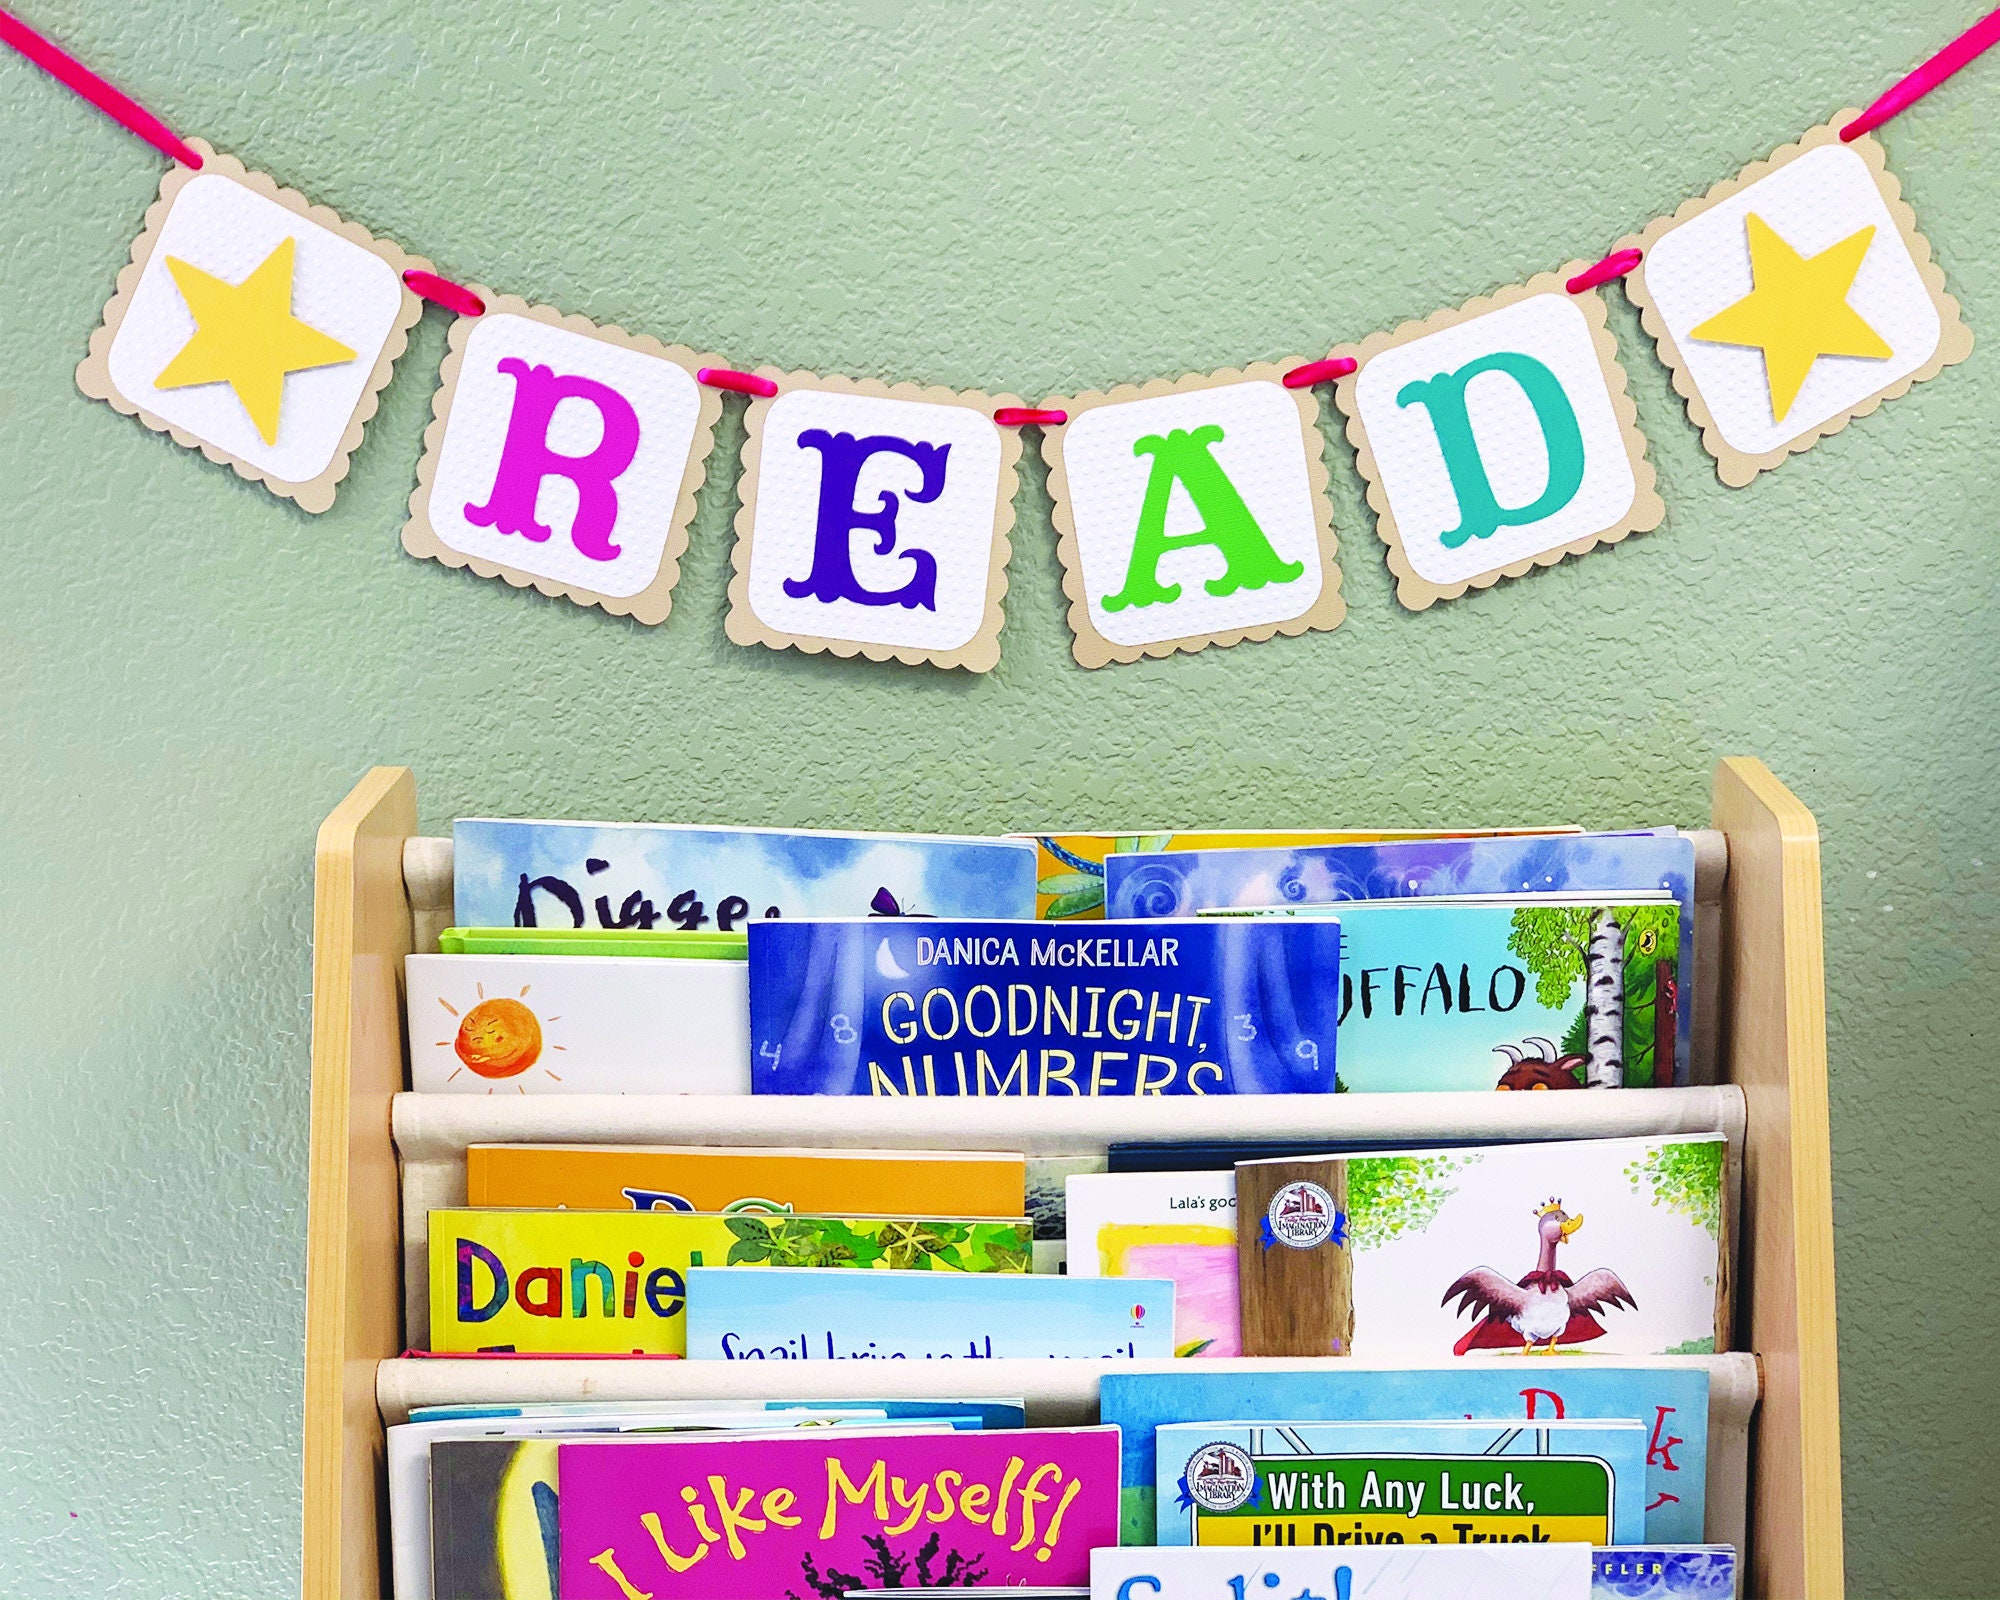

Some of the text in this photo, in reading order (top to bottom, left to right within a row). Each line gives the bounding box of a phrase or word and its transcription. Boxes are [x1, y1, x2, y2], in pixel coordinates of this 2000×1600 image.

[917, 937, 1179, 967] DANICA McKELLAR
[830, 1013, 858, 1044] 8
[881, 984, 1211, 1054] GOODNIGHT,
[1233, 1013, 1257, 1041] 3
[759, 1039, 782, 1072] 4
[1295, 1039, 1318, 1071] 9
[1170, 1196, 1205, 1209] Lala's
[456, 1238, 704, 1323] Danie
[1267, 1470, 1535, 1518] With Any Luck,
[589, 1456, 1082, 1600] I Like Myself!
